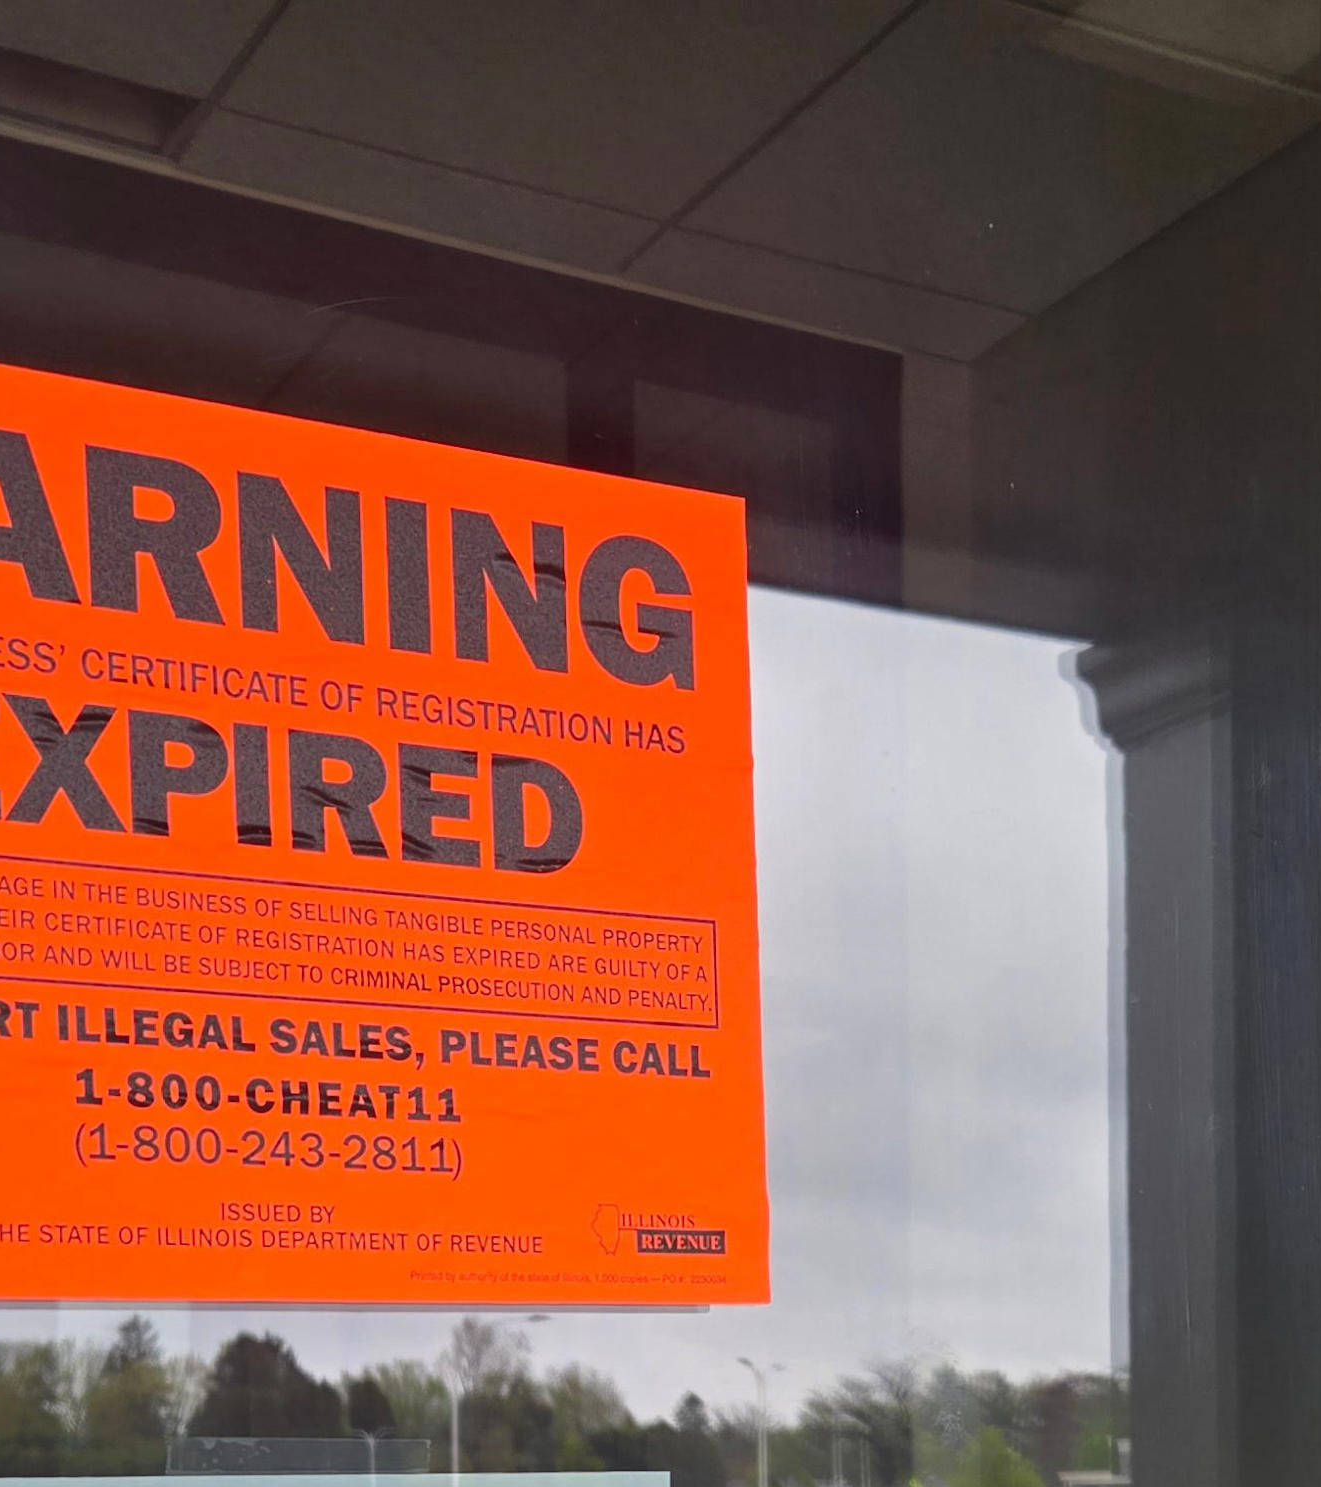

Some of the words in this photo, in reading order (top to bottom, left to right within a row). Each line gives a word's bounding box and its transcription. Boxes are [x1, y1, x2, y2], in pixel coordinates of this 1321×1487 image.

[81, 648, 308, 707] CERTIFICATE
[320, 680, 364, 713] OF
[376, 687, 612, 745] REGISTRATION
[624, 719, 686, 754] HAS
[53, 880, 75, 900] IN
[83, 883, 127, 905] THE
[136, 887, 247, 915] BUSINESS
[254, 898, 282, 918] OF
[289, 901, 377, 926] SELLING
[384, 910, 483, 936] TANGIBLE
[491, 919, 596, 945] PERSONAL
[603, 929, 703, 953] PROPERTY
[44, 912, 191, 942] CERTIFICATE
[198, 925, 227, 944] OF
[236, 928, 394, 958] REGISTRATION
[403, 942, 445, 962] HAS
[453, 946, 541, 970] EXPIRED
[548, 954, 587, 974] ARE
[594, 957, 660, 979] GUILTY
[666, 963, 690, 981] OF
[696, 965, 707, 982] A
[44, 945, 93, 966] AND
[100, 949, 156, 971] WILL
[164, 954, 191, 974] BE
[199, 957, 291, 981] SUBJECT
[297, 964, 323, 984] TO
[330, 967, 432, 992] CRIMINAL
[438, 975, 574, 1002] PROSECUTION
[582, 986, 622, 1005] AND
[628, 989, 712, 1012] PENALTY.
[57, 1004, 257, 1053] ILLEGAL
[269, 1018, 425, 1071] SALES,
[440, 1029, 600, 1072] PLEASE
[612, 1040, 711, 1079] CALL
[75, 1068, 462, 1123] 1-800-CHEAT11
[75, 1122, 462, 1182] (1-800-243-2811)
[40, 1225, 109, 1244] STATE
[118, 1226, 147, 1245] OF
[158, 1227, 253, 1248] ILLINOIS
[262, 1230, 407, 1251] DEPARTMENT
[416, 1233, 442, 1252] OF
[450, 1234, 542, 1254] REVENUE
[221, 1203, 301, 1222] ISSUED
[310, 1205, 333, 1223] BY
[622, 1213, 695, 1228] ILLINOIS
[640, 1233, 722, 1251] REVENUE
